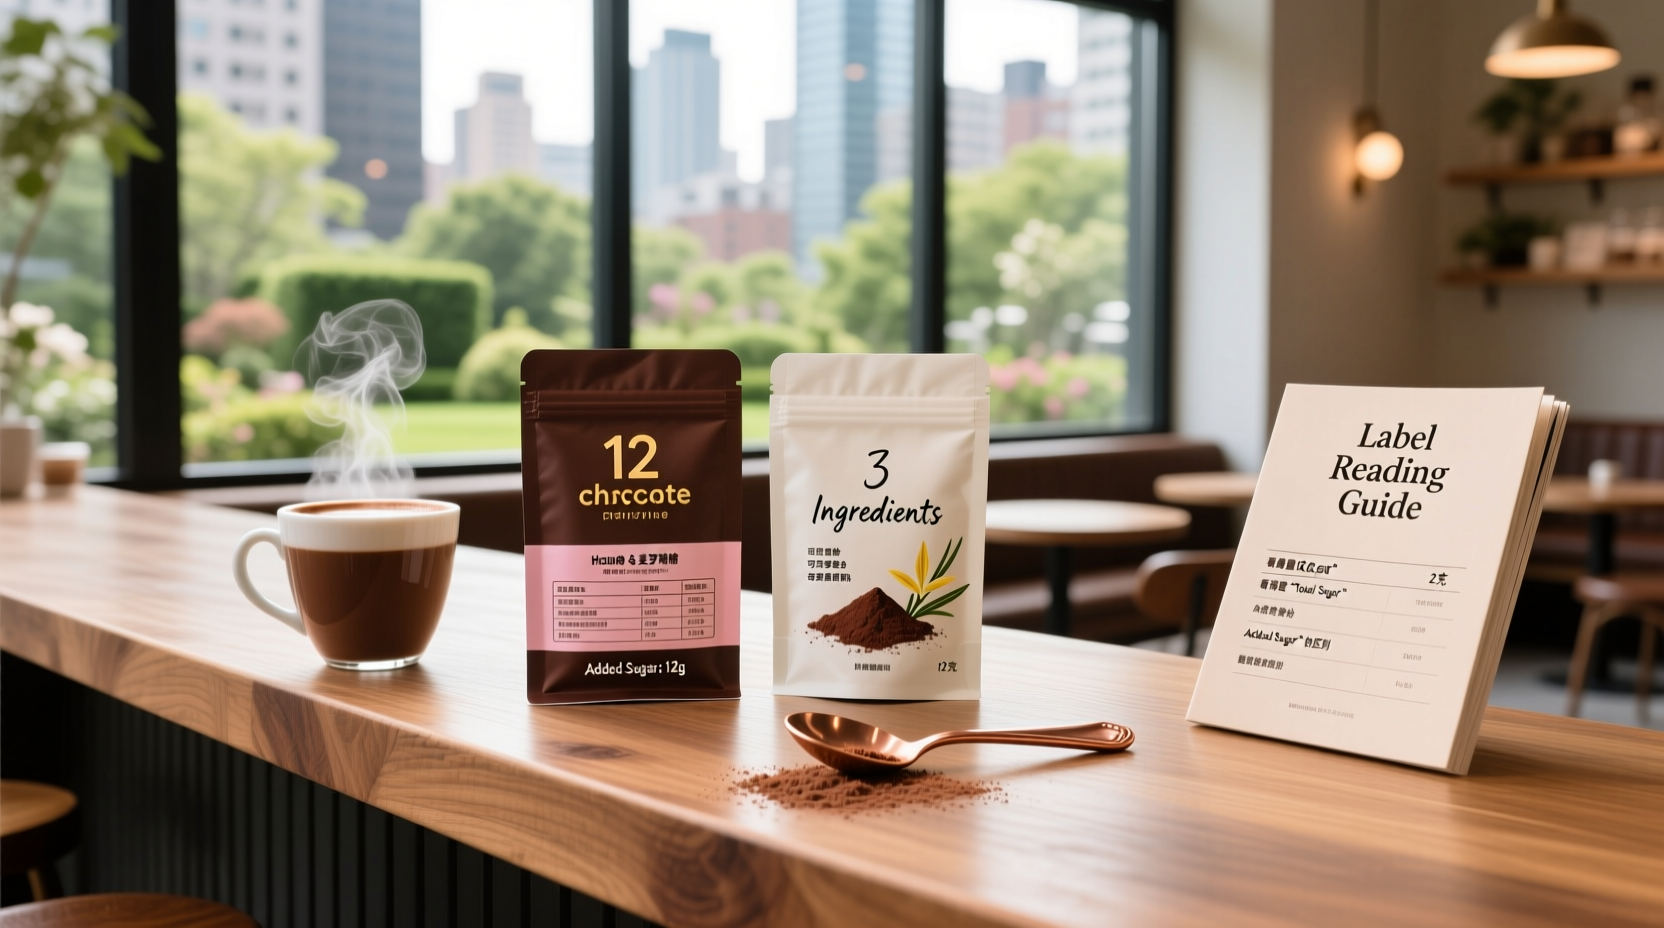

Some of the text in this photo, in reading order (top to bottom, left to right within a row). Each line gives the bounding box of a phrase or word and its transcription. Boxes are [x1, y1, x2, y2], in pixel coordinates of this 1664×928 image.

[1357, 422, 1438, 451] Label
[603, 434, 659, 480] 12
[863, 448, 890, 490] 3
[1329, 454, 1450, 494] Reading
[812, 494, 943, 534] Ingredients
[1338, 489, 1423, 520] Guide
[584, 661, 623, 676] Added
[665, 660, 686, 676] 12g
